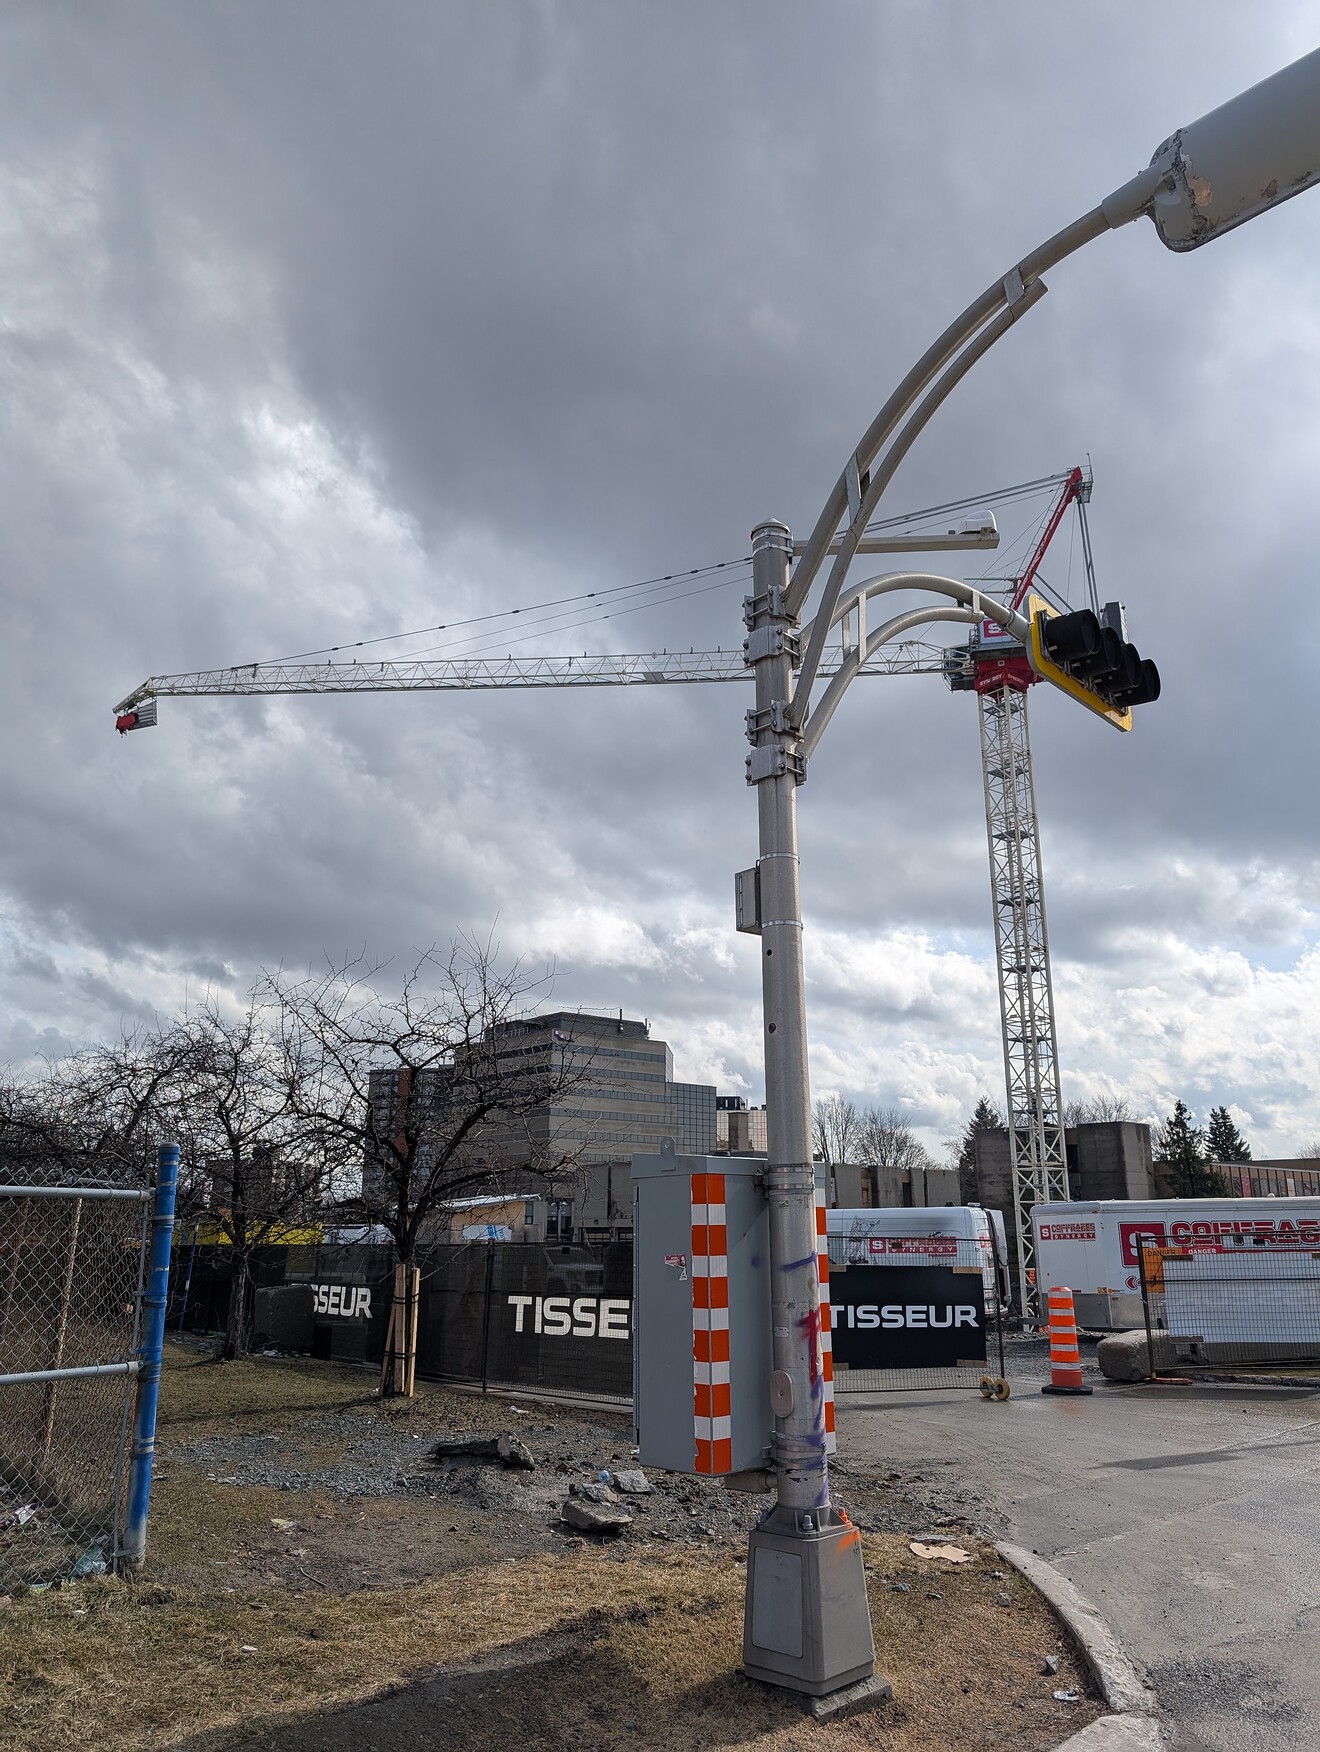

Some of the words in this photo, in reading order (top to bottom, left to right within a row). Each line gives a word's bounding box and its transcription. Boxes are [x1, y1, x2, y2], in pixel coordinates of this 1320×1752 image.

[1041, 1228, 1050, 1237] S
[872, 1240, 884, 1250] S
[1147, 1249, 1176, 1257] DANGER
[292, 1284, 373, 1318] SSEUR
[830, 1305, 979, 1328] TISSEUR
